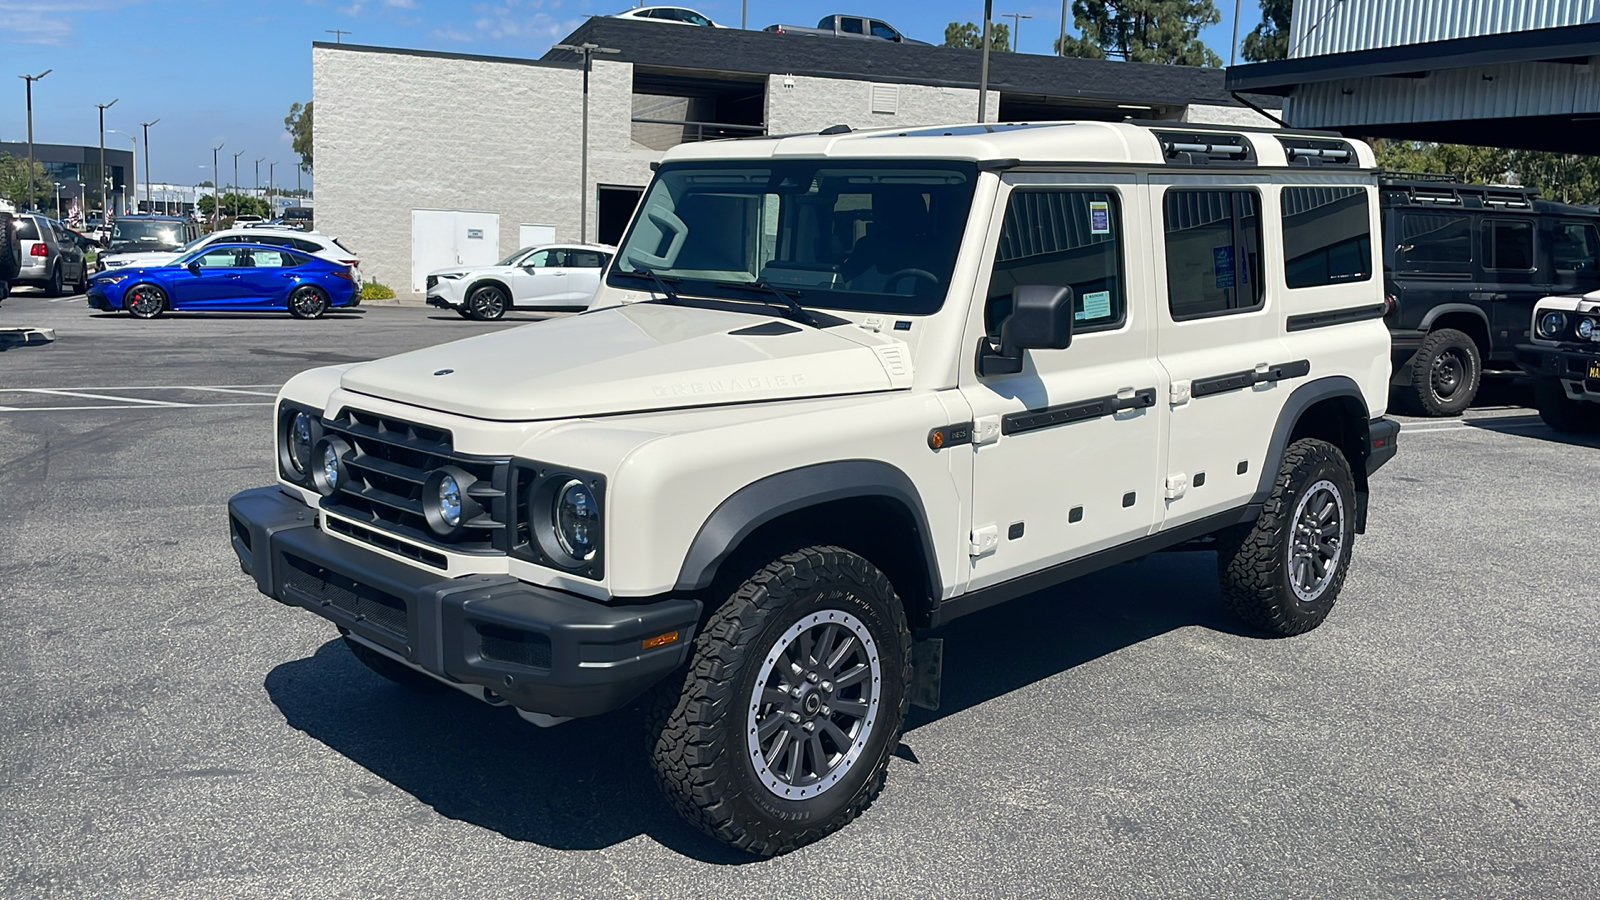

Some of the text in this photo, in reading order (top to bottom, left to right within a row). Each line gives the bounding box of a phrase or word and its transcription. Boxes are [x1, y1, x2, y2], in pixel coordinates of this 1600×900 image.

[1589, 366, 1600, 378] MA
[652, 373, 806, 397] GRENADIER
[951, 430, 967, 439] INEOS
